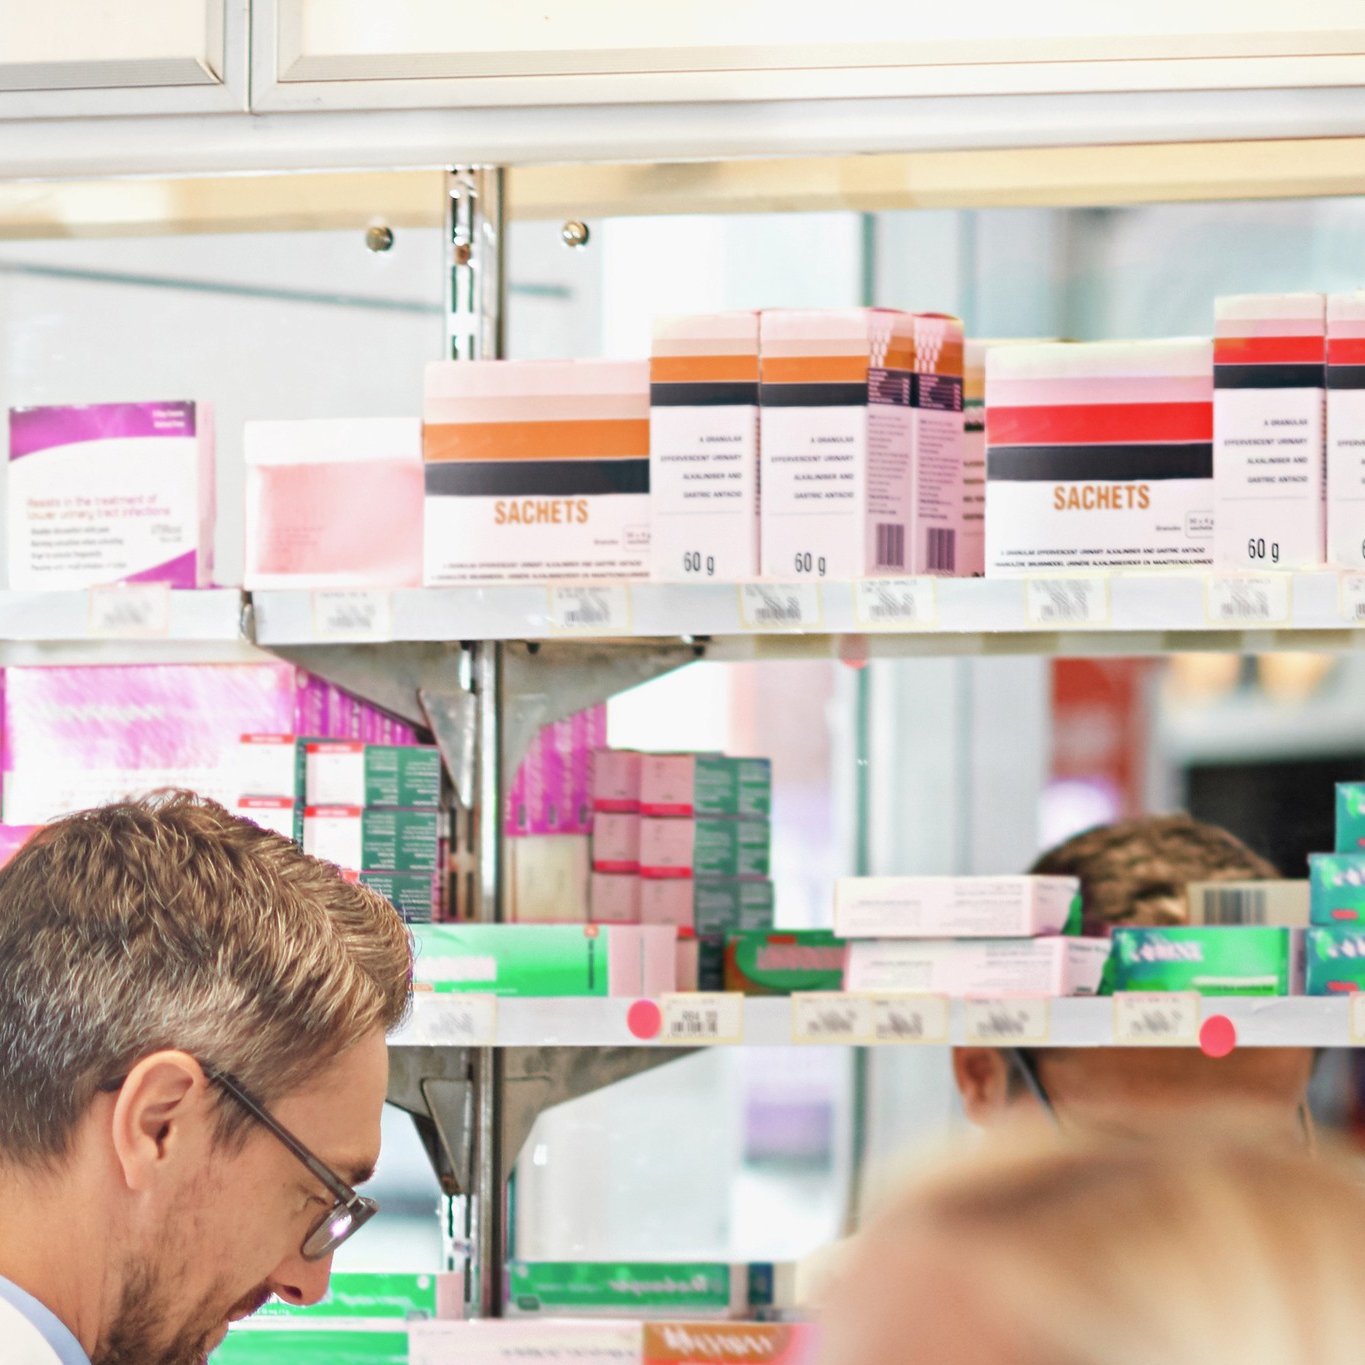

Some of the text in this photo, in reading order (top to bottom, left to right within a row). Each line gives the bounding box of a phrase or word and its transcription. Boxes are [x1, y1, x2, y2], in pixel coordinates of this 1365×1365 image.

[76, 496, 91, 507] the
[1053, 483, 1150, 511] SACHETS
[494, 498, 589, 525] SACHETS
[1248, 538, 1279, 563] 60 g
[684, 551, 714, 576] 60 g
[795, 552, 826, 576] 60 g
